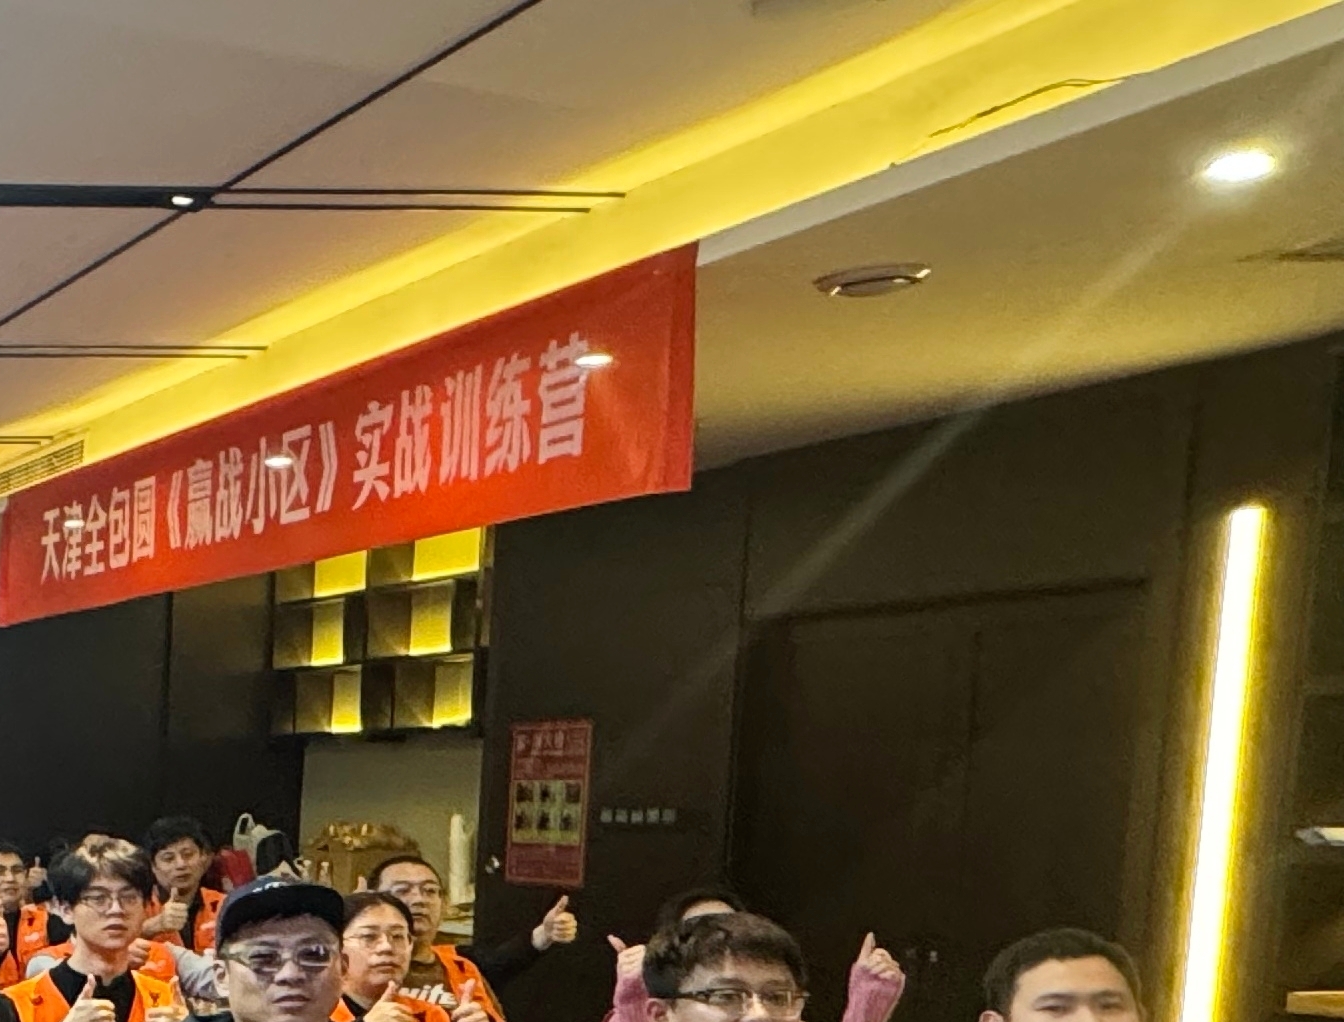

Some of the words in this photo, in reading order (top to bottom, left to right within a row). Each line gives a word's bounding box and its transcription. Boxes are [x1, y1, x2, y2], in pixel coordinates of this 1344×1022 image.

[40, 331, 590, 584] 天津全包圆《赢战小区》实战训练营
